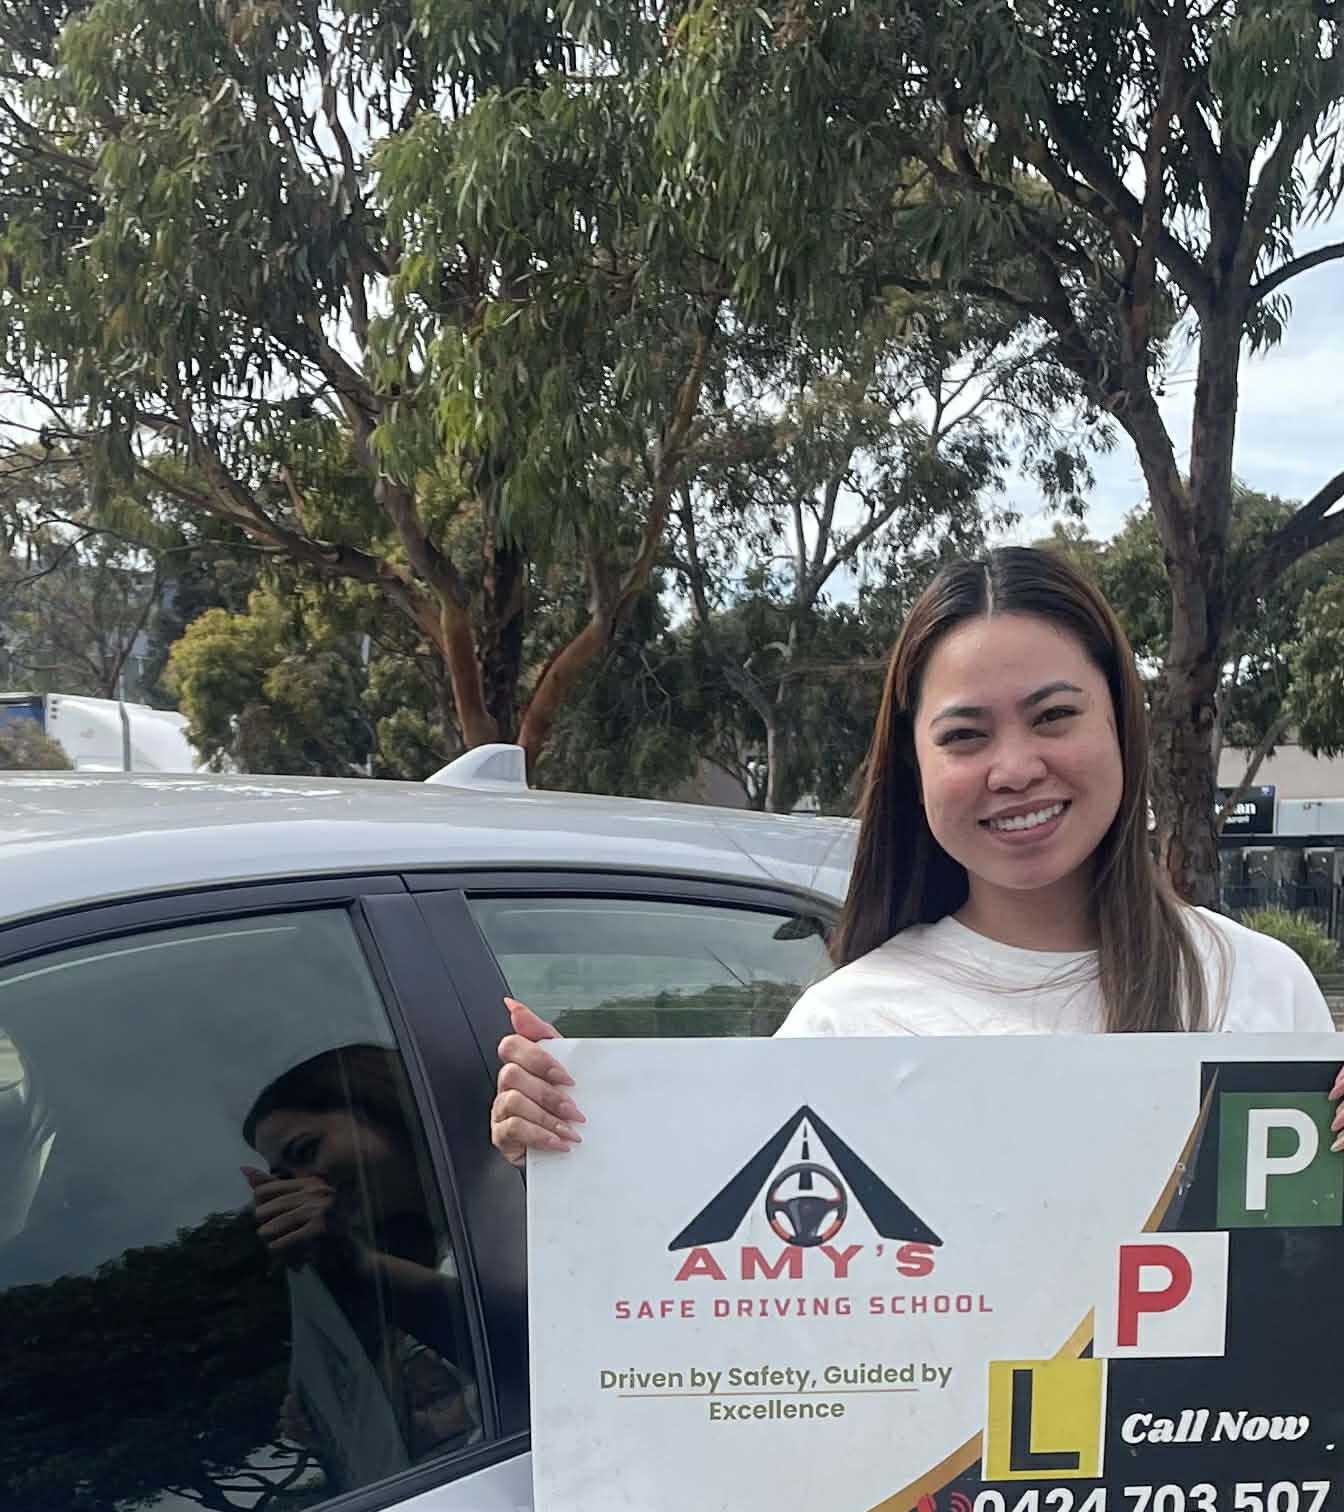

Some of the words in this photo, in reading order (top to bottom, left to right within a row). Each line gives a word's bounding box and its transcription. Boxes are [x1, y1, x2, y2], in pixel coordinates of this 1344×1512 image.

[1245, 1107, 1319, 1211] P
[673, 1243, 935, 1281] AMY'S
[615, 1299, 697, 1319] SAFE
[714, 1296, 852, 1318] DRIVING
[869, 1294, 994, 1315] SCHOOL
[1117, 1244, 1192, 1347] P
[600, 1366, 683, 1389] Driven
[690, 1365, 722, 1394] by
[728, 1364, 817, 1393] Safety,
[823, 1363, 915, 1385] Guided
[921, 1362, 953, 1388] by
[709, 1399, 846, 1421] Excellence
[1009, 1367, 1081, 1471] L
[1120, 1408, 1210, 1444] Call
[1209, 1409, 1311, 1442] Now
